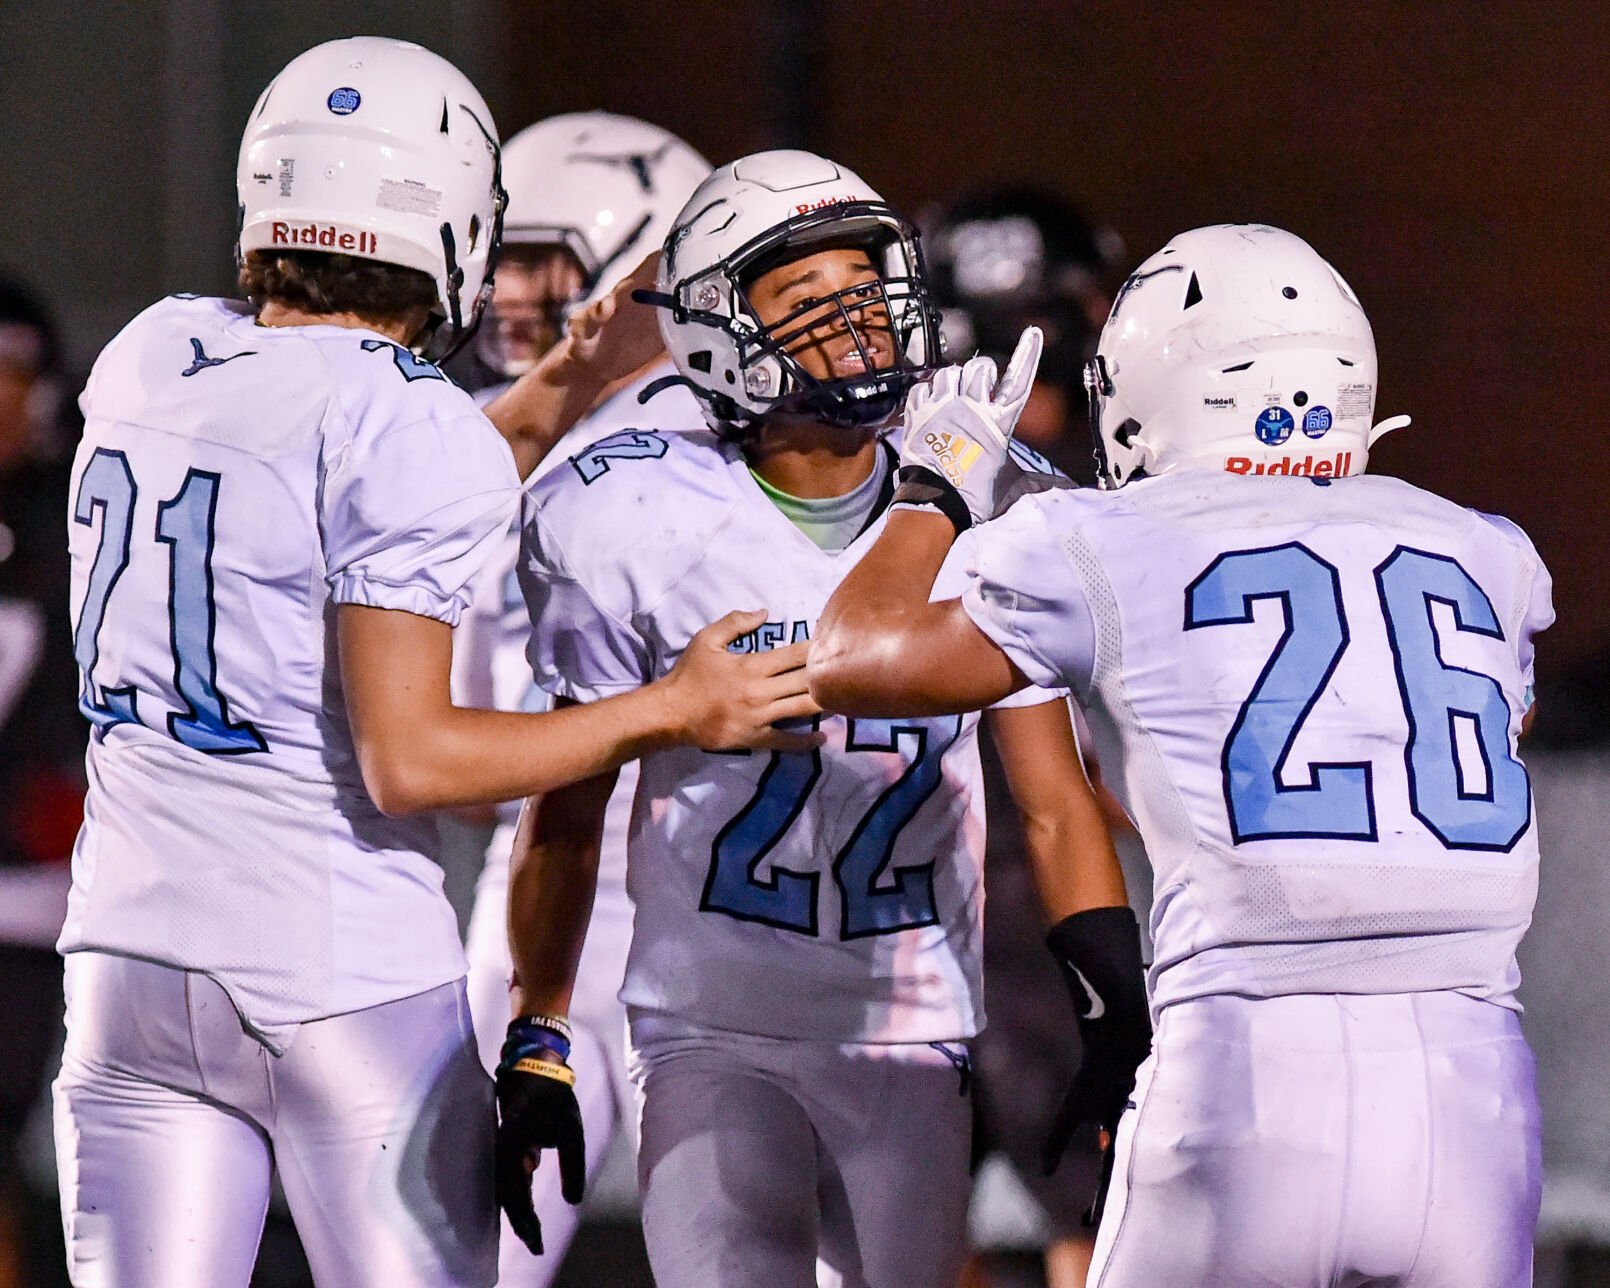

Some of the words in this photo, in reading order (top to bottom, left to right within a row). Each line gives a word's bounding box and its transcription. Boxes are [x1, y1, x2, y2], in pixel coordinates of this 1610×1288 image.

[331, 90, 358, 109] 66
[272, 222, 376, 253] Riddell
[1204, 397, 1234, 405] Riddell
[1269, 409, 1281, 420] 31
[1306, 409, 1329, 430] 66
[1261, 428, 1267, 438] L
[925, 432, 963, 487] adidas
[1225, 452, 1352, 478] Riddell
[74, 446, 272, 754] 21
[1183, 540, 1532, 853] 26
[698, 712, 964, 942] 22
